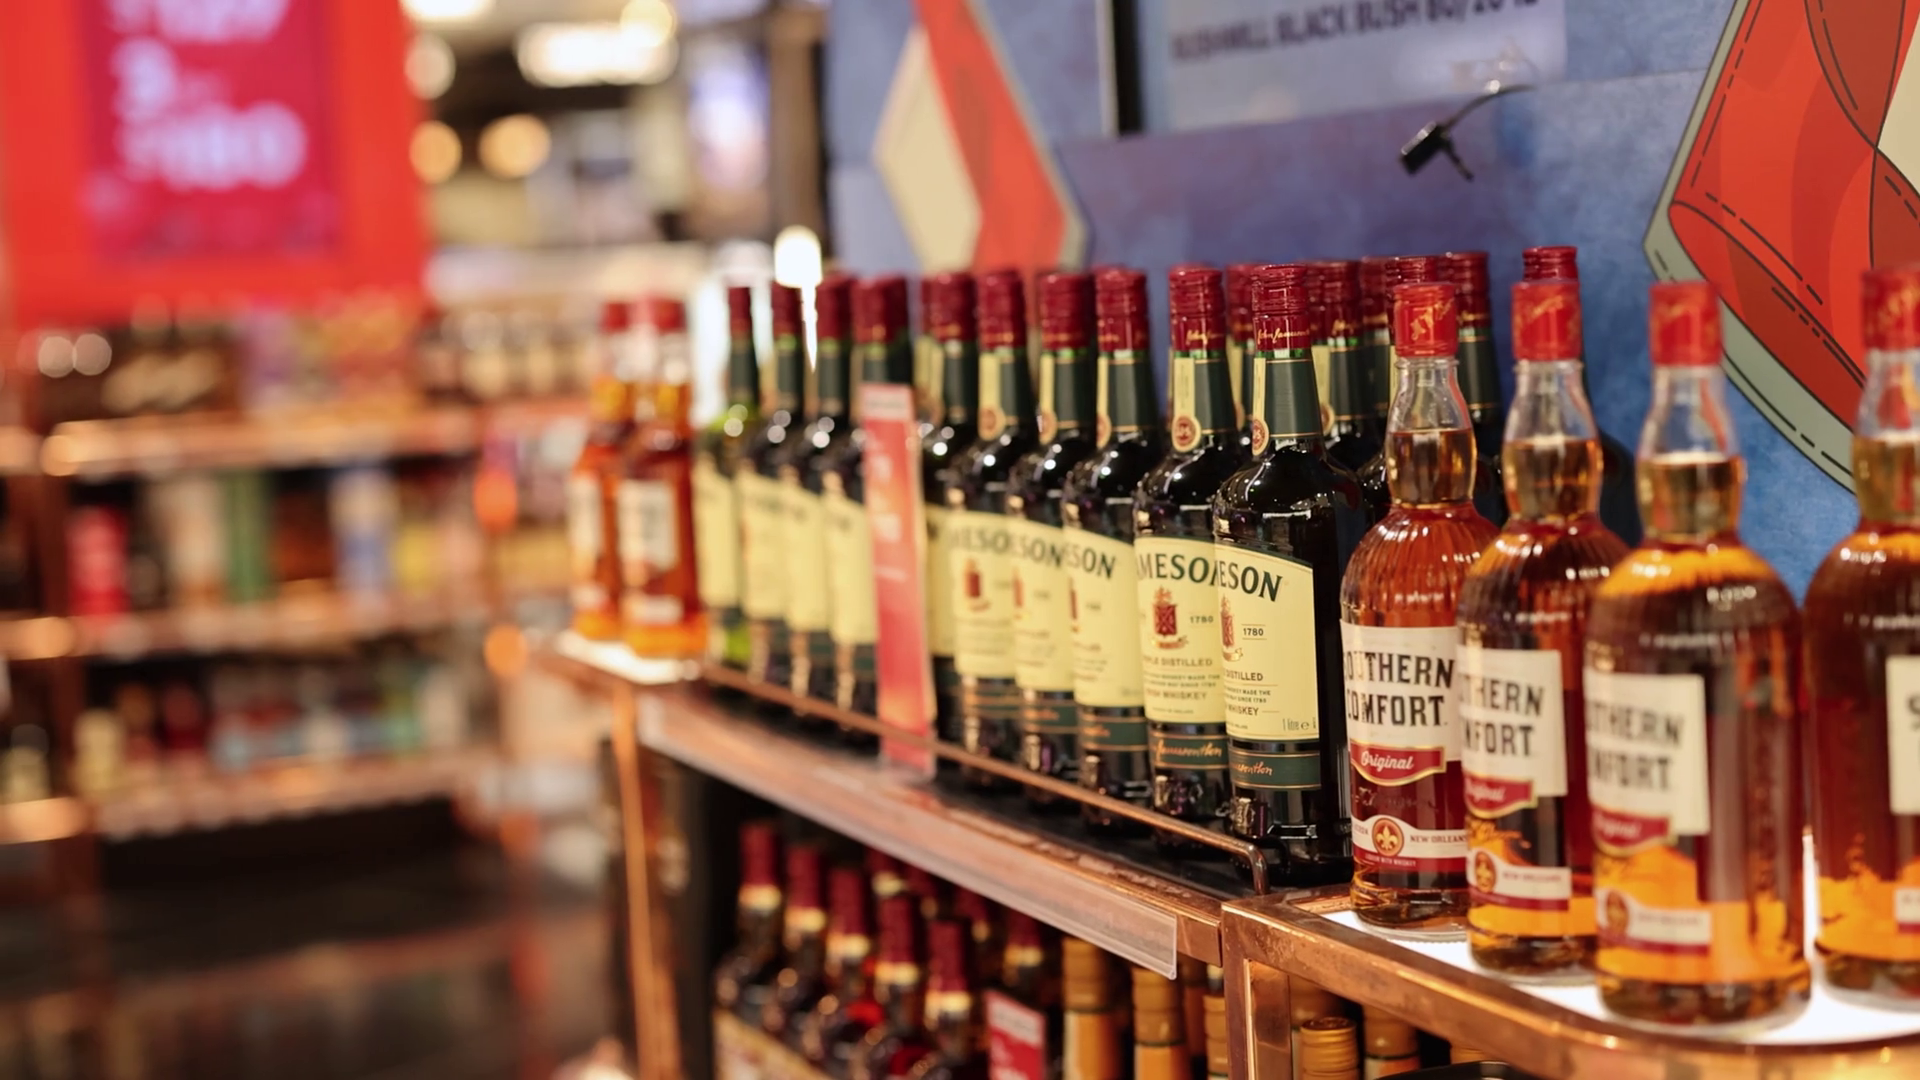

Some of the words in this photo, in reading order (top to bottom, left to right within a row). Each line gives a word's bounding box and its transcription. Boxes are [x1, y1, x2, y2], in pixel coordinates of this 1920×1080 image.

[1190, 615, 1214, 624] 1780
[1242, 626, 1265, 637] 1780
[1161, 657, 1213, 668] DISTILLED
[1163, 691, 1208, 700] WHISKEY
[1360, 750, 1415, 773] Original
[1410, 835, 1429, 843] NEW
